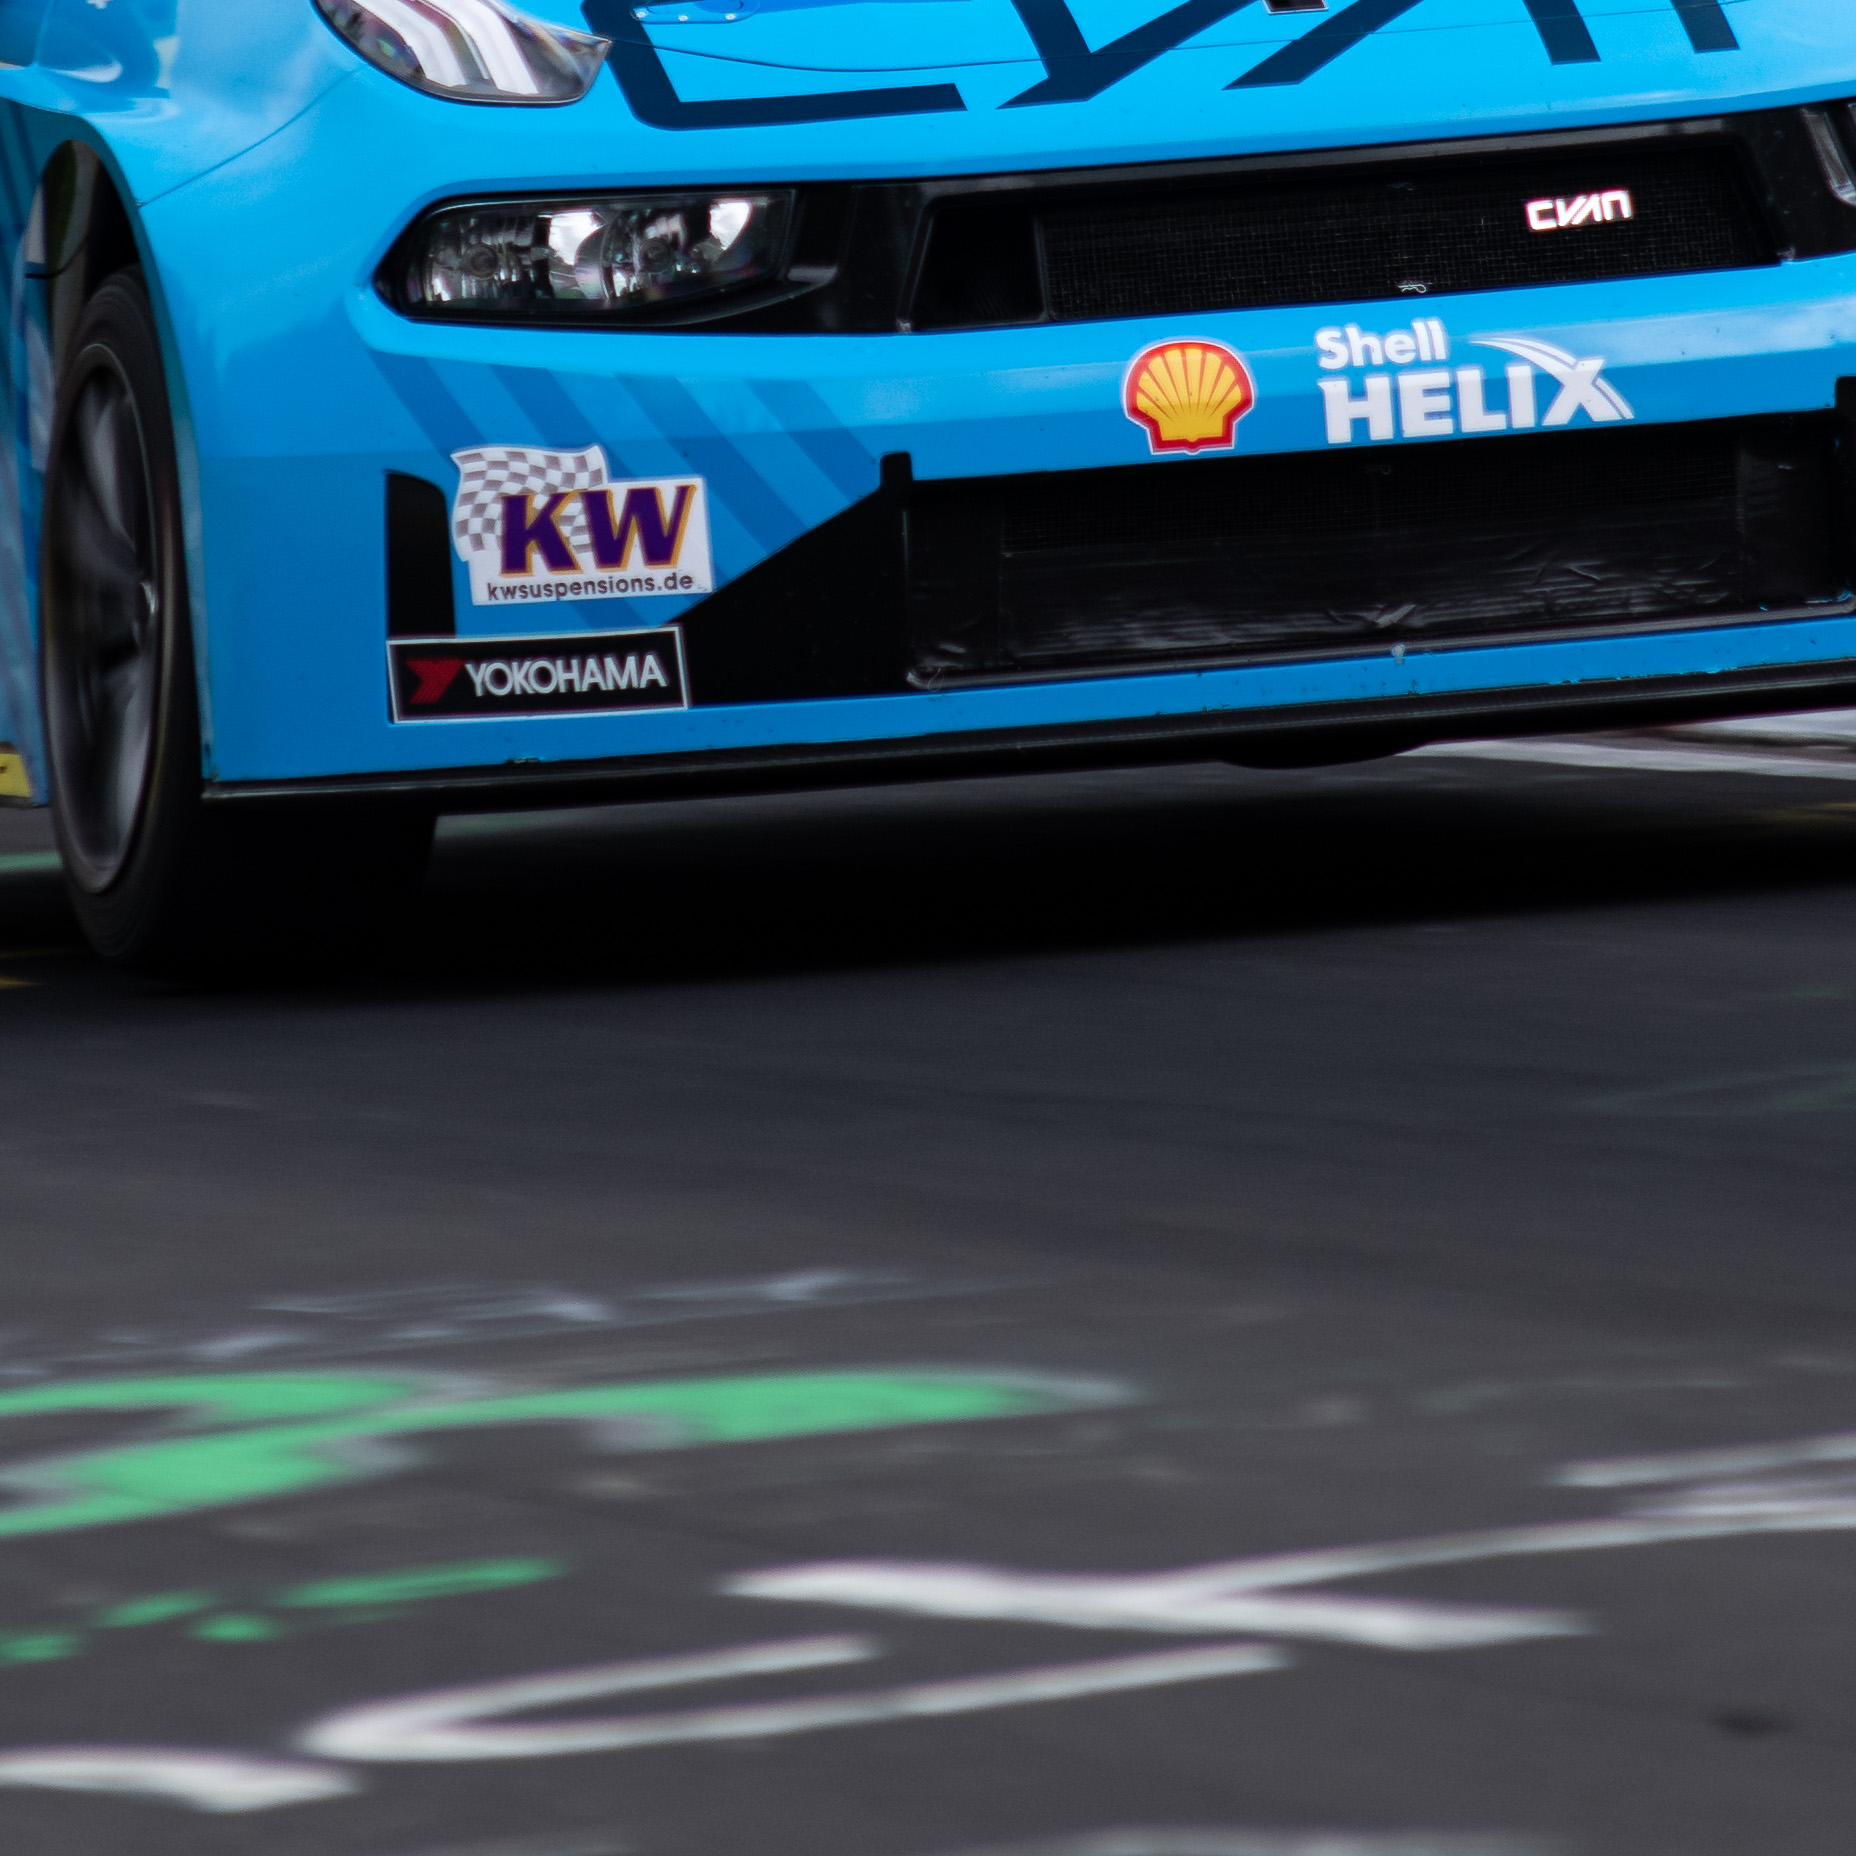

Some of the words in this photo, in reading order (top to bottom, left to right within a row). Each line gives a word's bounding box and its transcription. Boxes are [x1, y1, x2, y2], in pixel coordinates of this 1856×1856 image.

[1315, 318, 1447, 370] Shell
[1319, 356, 1635, 444] HELIX
[499, 483, 695, 576] KW
[486, 571, 695, 603] kwsuspensions.de
[465, 653, 668, 697] YOKOHAMA
